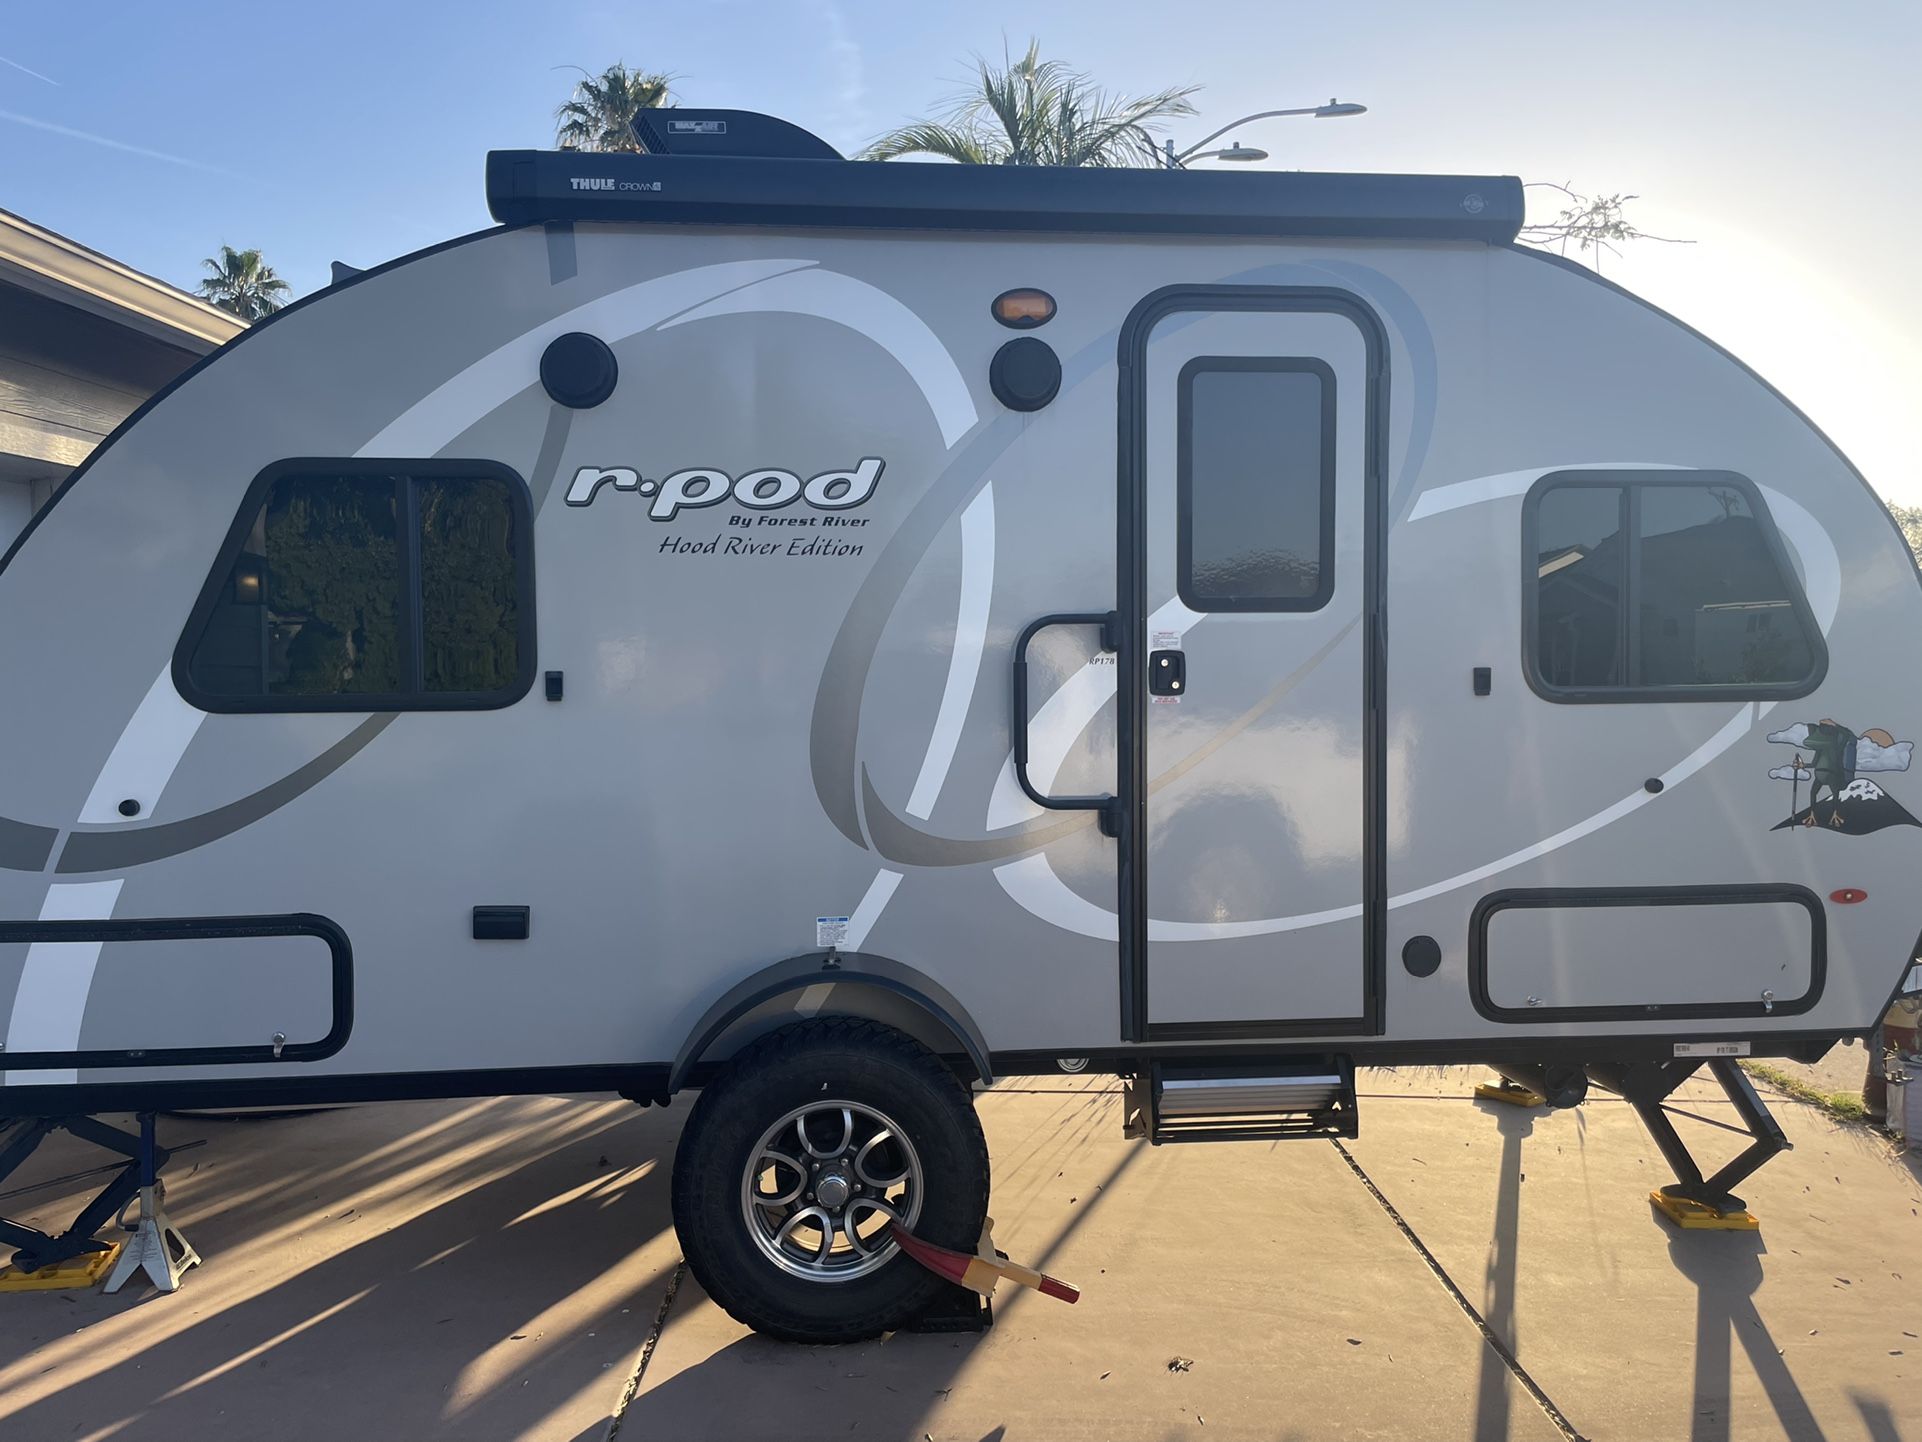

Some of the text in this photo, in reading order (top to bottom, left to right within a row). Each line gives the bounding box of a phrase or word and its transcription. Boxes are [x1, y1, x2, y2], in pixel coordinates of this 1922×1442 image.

[570, 178, 615, 191] THULE
[728, 515, 870, 528] By Forest River
[658, 534, 863, 556] Hood River Edition
[1088, 657, 1115, 665] RP178
